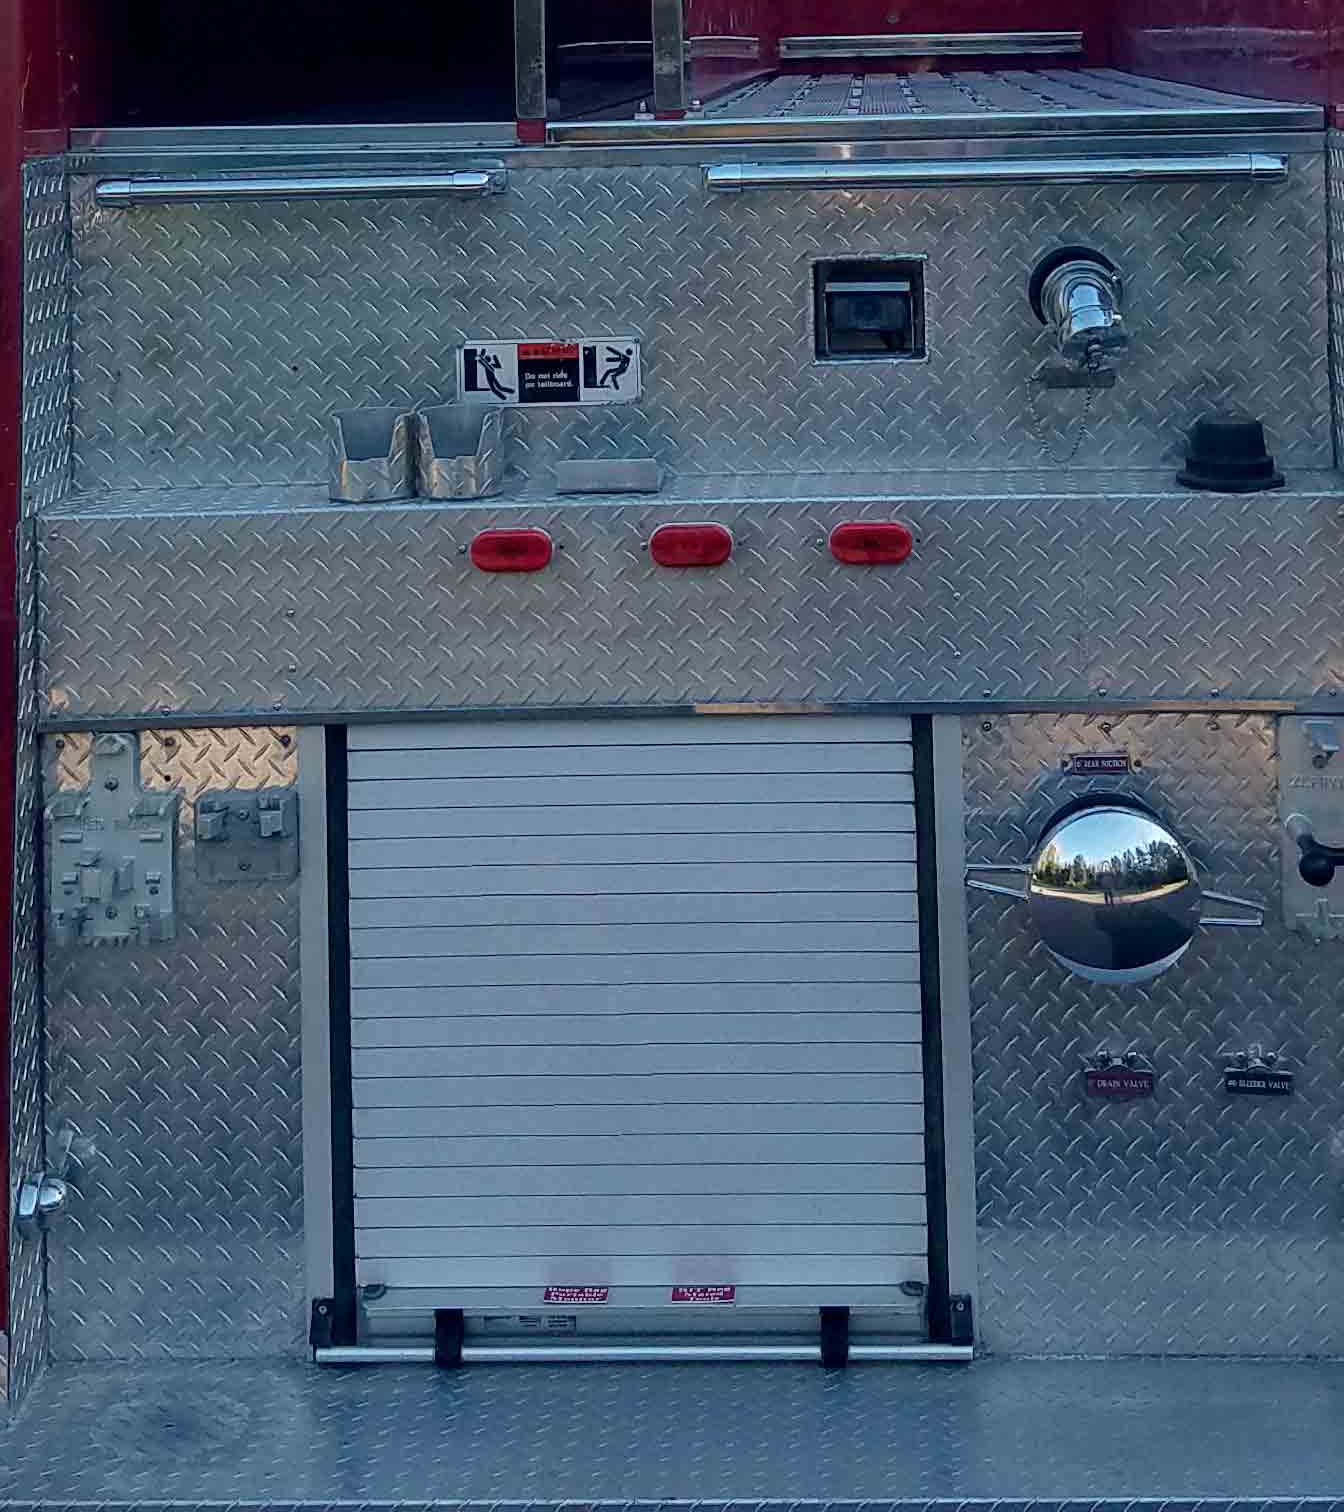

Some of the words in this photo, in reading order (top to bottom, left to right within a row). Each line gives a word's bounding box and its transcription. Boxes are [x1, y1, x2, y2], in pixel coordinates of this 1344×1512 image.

[524, 372, 536, 380] Do
[537, 371, 551, 380] not
[552, 368, 568, 380] ride
[1097, 1079, 1121, 1088] DRAIN
[1123, 1079, 1151, 1089] VALVE
